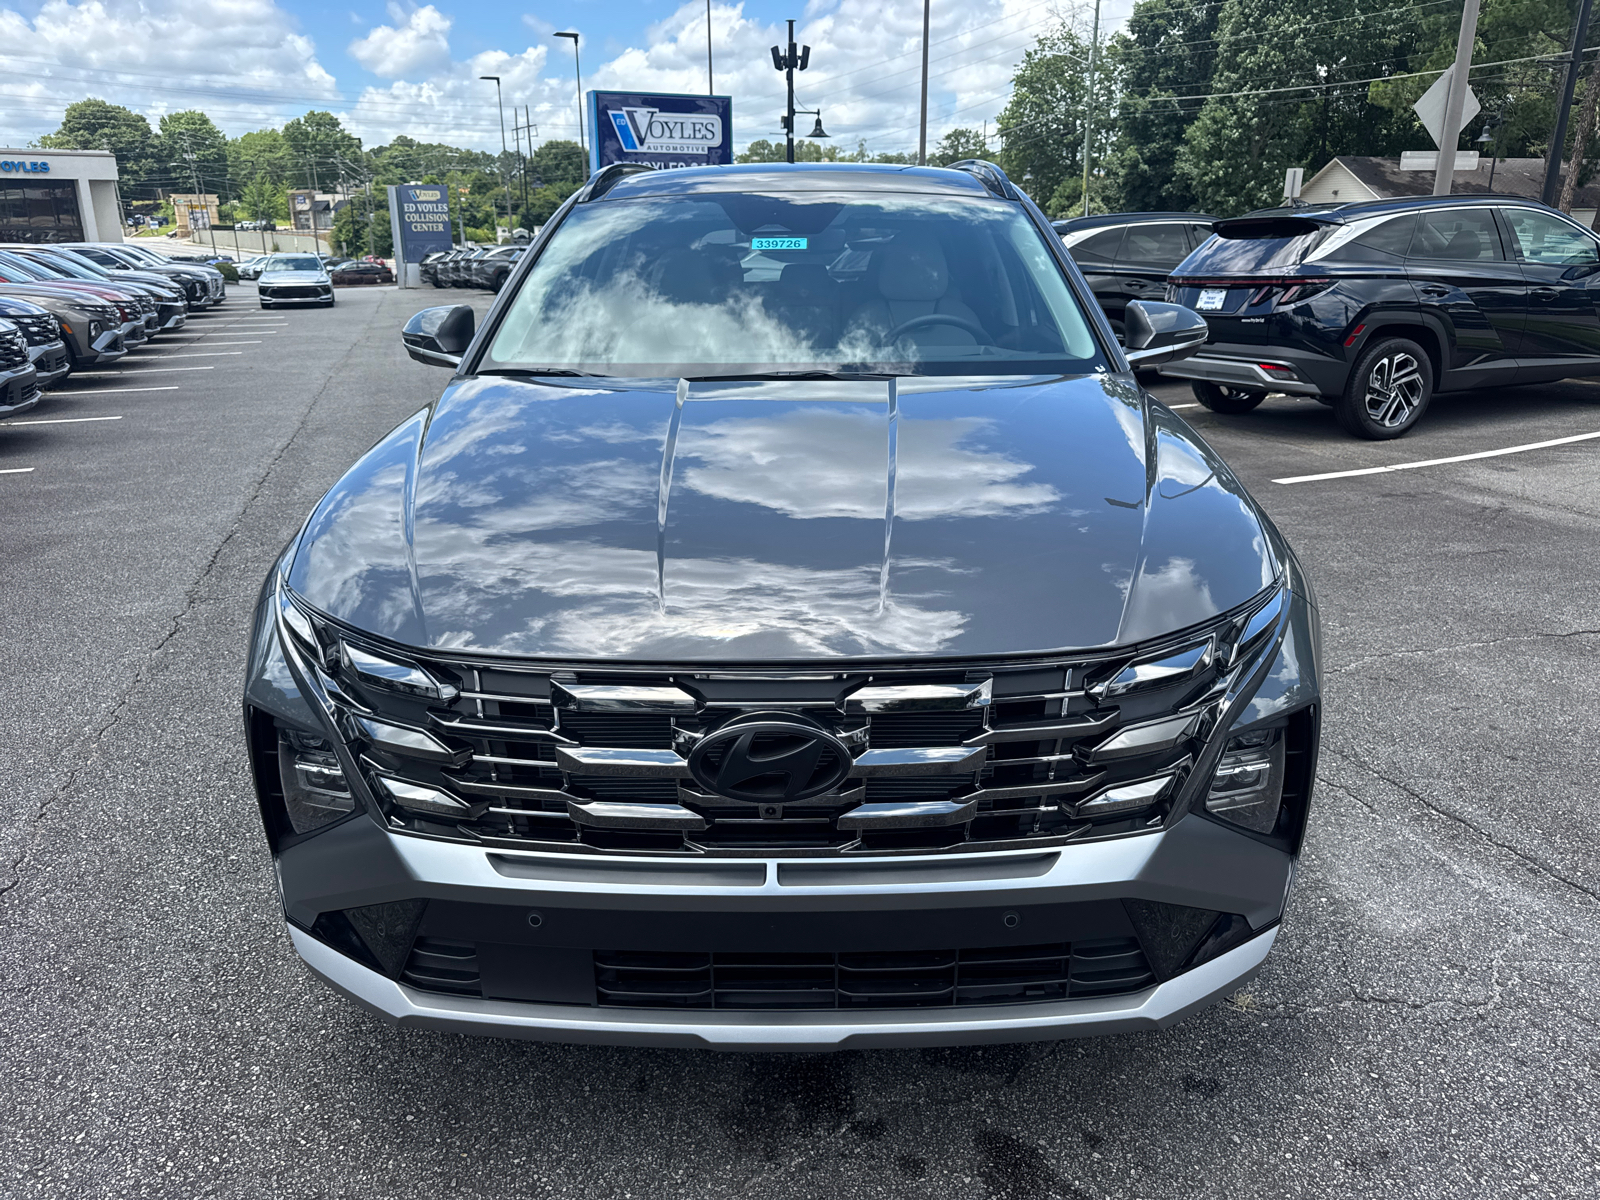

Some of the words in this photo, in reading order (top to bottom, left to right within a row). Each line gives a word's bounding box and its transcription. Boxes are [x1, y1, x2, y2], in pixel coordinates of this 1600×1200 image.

[616, 118, 627, 126] ED
[625, 109, 716, 147] VOYLES
[646, 145, 707, 153] AUTOMOTIVE
[0, 160, 50, 173] OYLES
[404, 203, 416, 212] ED
[417, 203, 449, 212] VOYLES
[405, 213, 449, 222] COLLISION
[411, 223, 444, 232] CENTER
[756, 239, 801, 248] 339726
